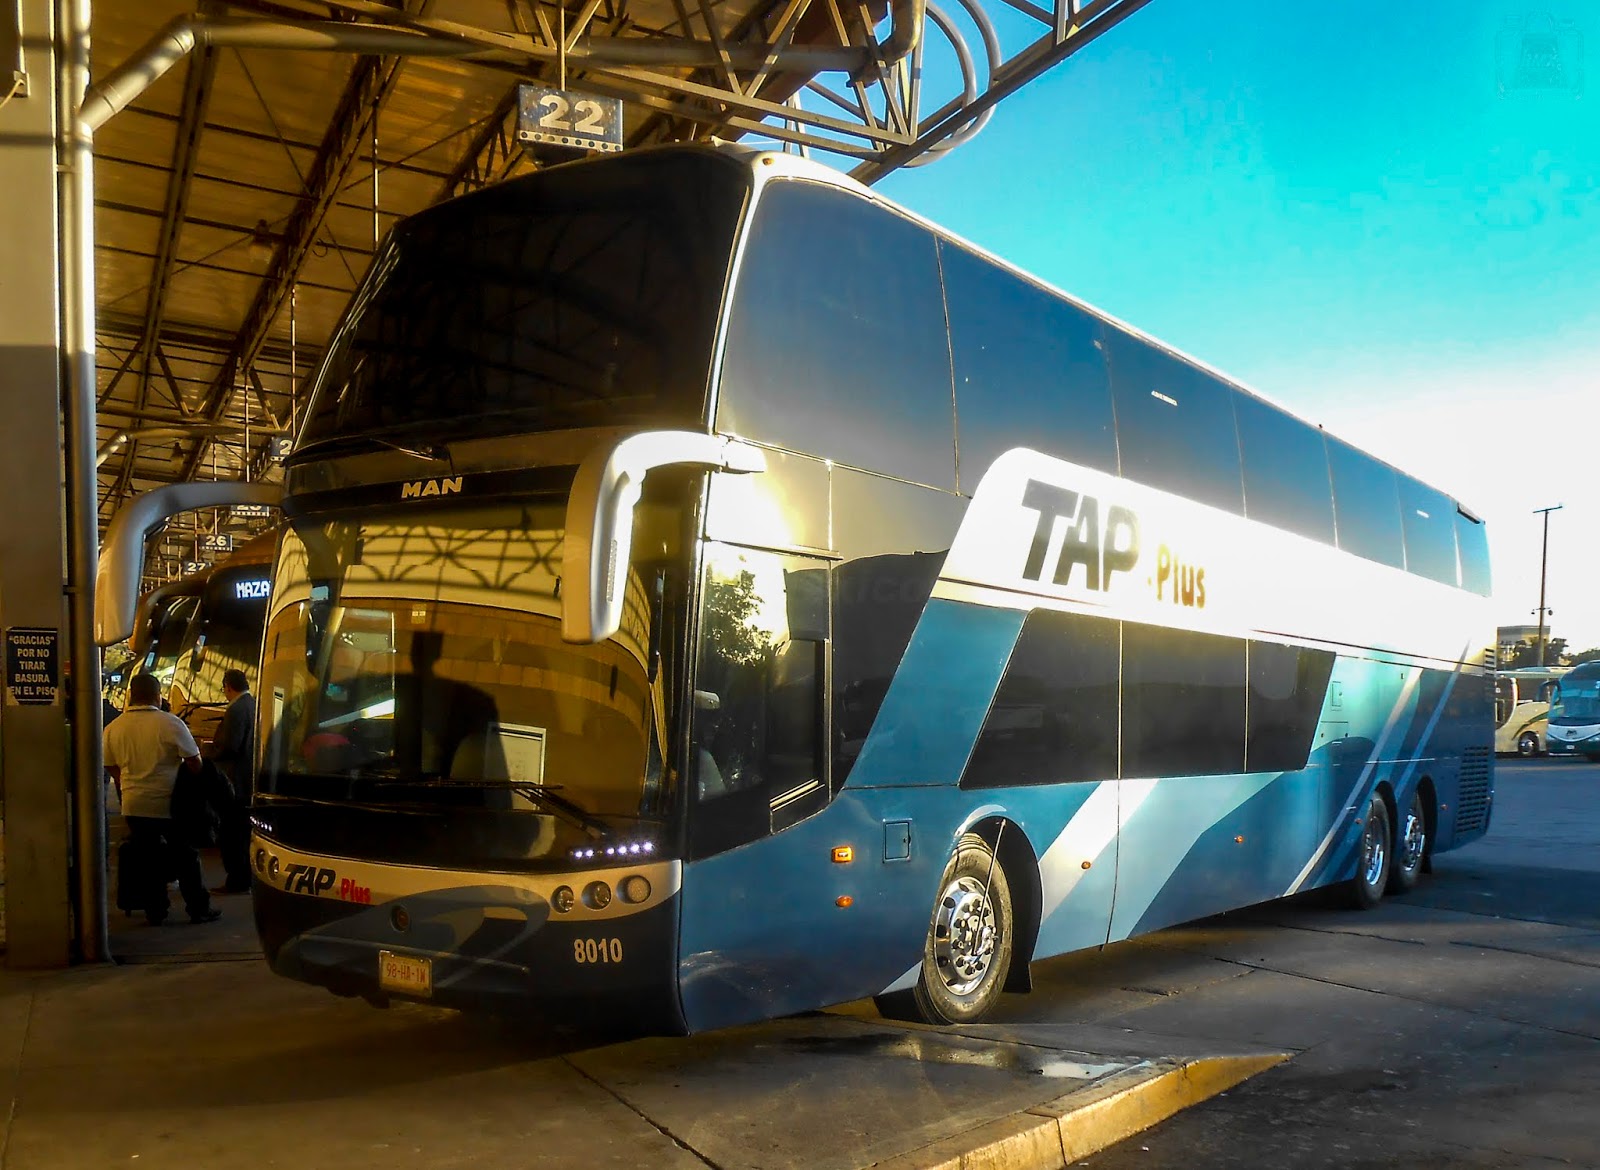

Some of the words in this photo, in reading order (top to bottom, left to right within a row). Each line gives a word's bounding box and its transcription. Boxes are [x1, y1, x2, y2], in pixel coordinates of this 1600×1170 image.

[540, 95, 604, 135] 22
[401, 476, 463, 498] MAN
[205, 535, 227, 546] 26
[1021, 478, 1140, 592] TAP
[187, 562, 206, 572] 27
[235, 580, 271, 598] MAZA
[17, 648, 35, 658] POR
[36, 648, 50, 658] NO
[19, 661, 46, 670] TIRAR
[15, 673, 50, 683] BASURA
[11, 686, 21, 695] EN
[23, 686, 34, 695] EL
[284, 863, 337, 896] TAP
[573, 937, 623, 963] 8010
